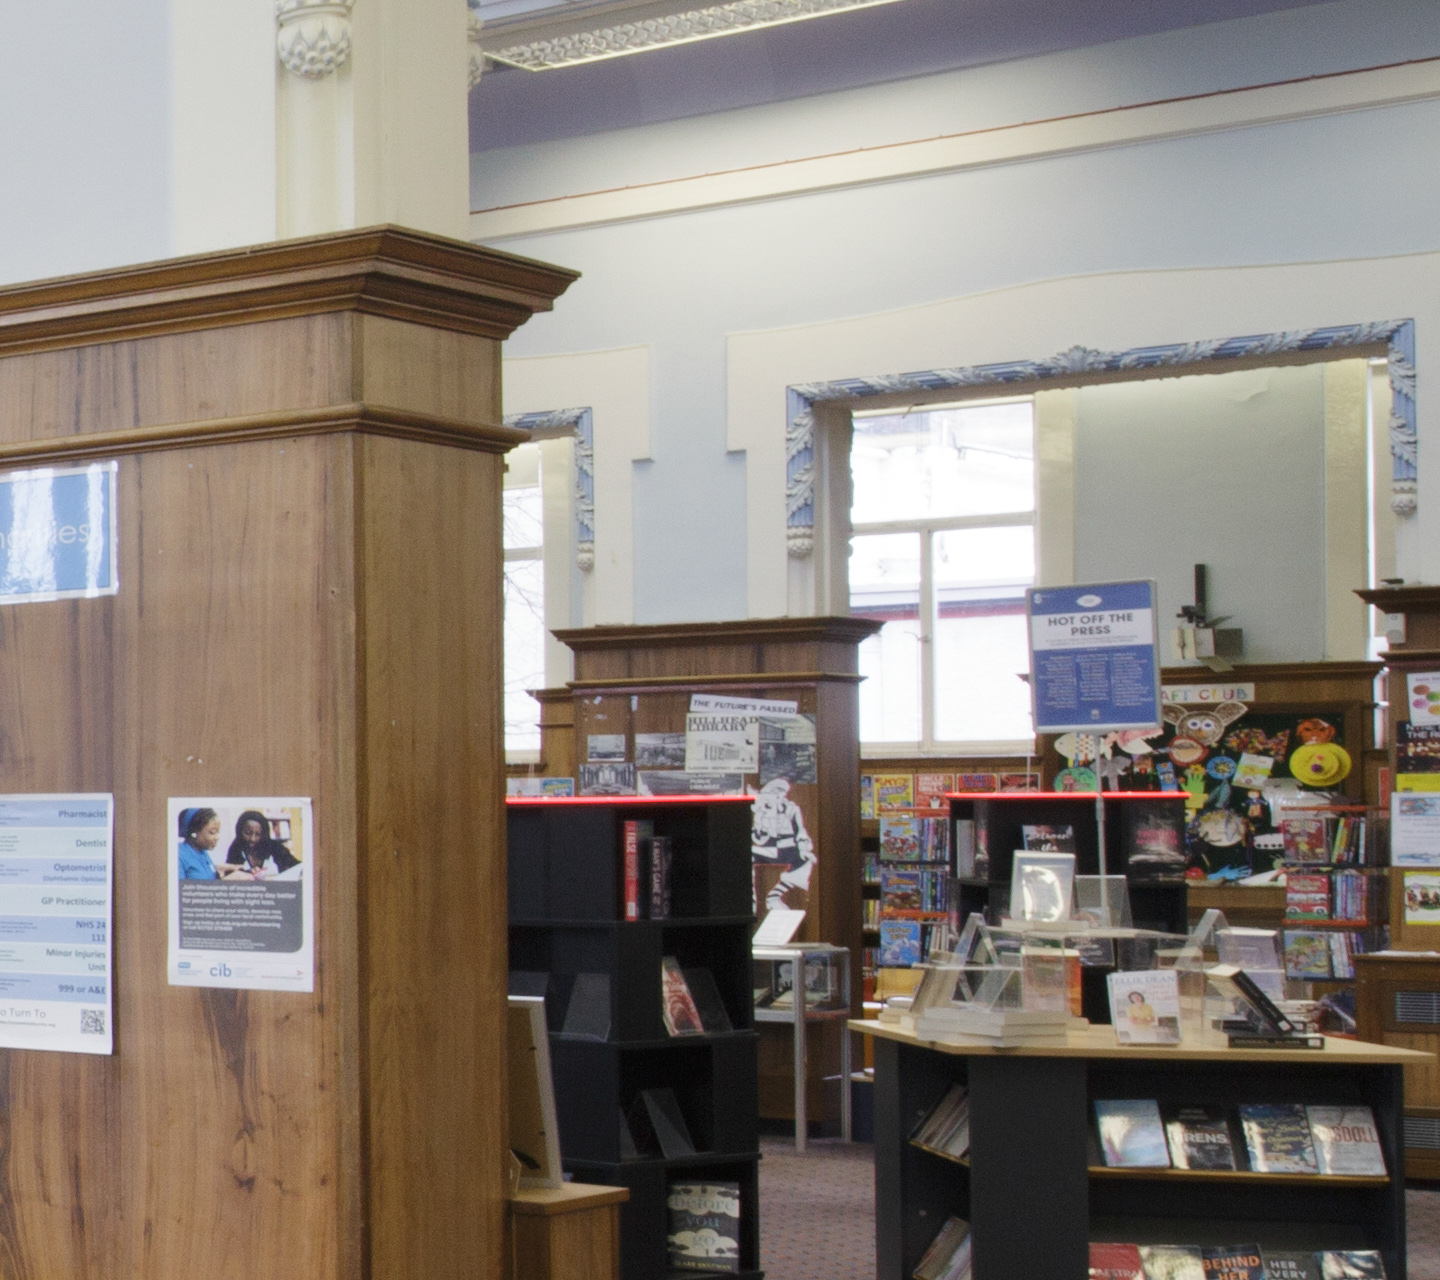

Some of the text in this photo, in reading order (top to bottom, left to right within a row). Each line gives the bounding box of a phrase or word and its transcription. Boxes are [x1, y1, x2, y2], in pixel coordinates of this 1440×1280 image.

[1048, 613, 1134, 626] HOT OFF THE
[1071, 625, 1111, 636] PRESS
[1199, 687, 1248, 700] CLUB
[693, 700, 796, 715] THE FUTURE'S PASSED
[688, 716, 759, 725] HILLHEAD
[688, 723, 748, 733] LIBRARY
[58, 809, 107, 819] Pharmacist
[75, 838, 107, 848] Dentist
[53, 863, 107, 873] Optometrist
[41, 897, 106, 907] GP Practitioner
[75, 920, 106, 929] NHS 24
[91, 933, 106, 942] 111
[46, 948, 106, 960] Minor Injuries
[88, 962, 106, 972] Unit
[210, 963, 232, 977] cib
[1113, 975, 1177, 984] ELLIE DEAN
[58, 984, 106, 995] 999 or A&E
[9, 1007, 30, 1017] Turn
[33, 1008, 46, 1018] To
[1203, 1255, 1260, 1270] BEHIND
[1270, 1260, 1297, 1269] HER
[1266, 1270, 1307, 1279] EVERY
